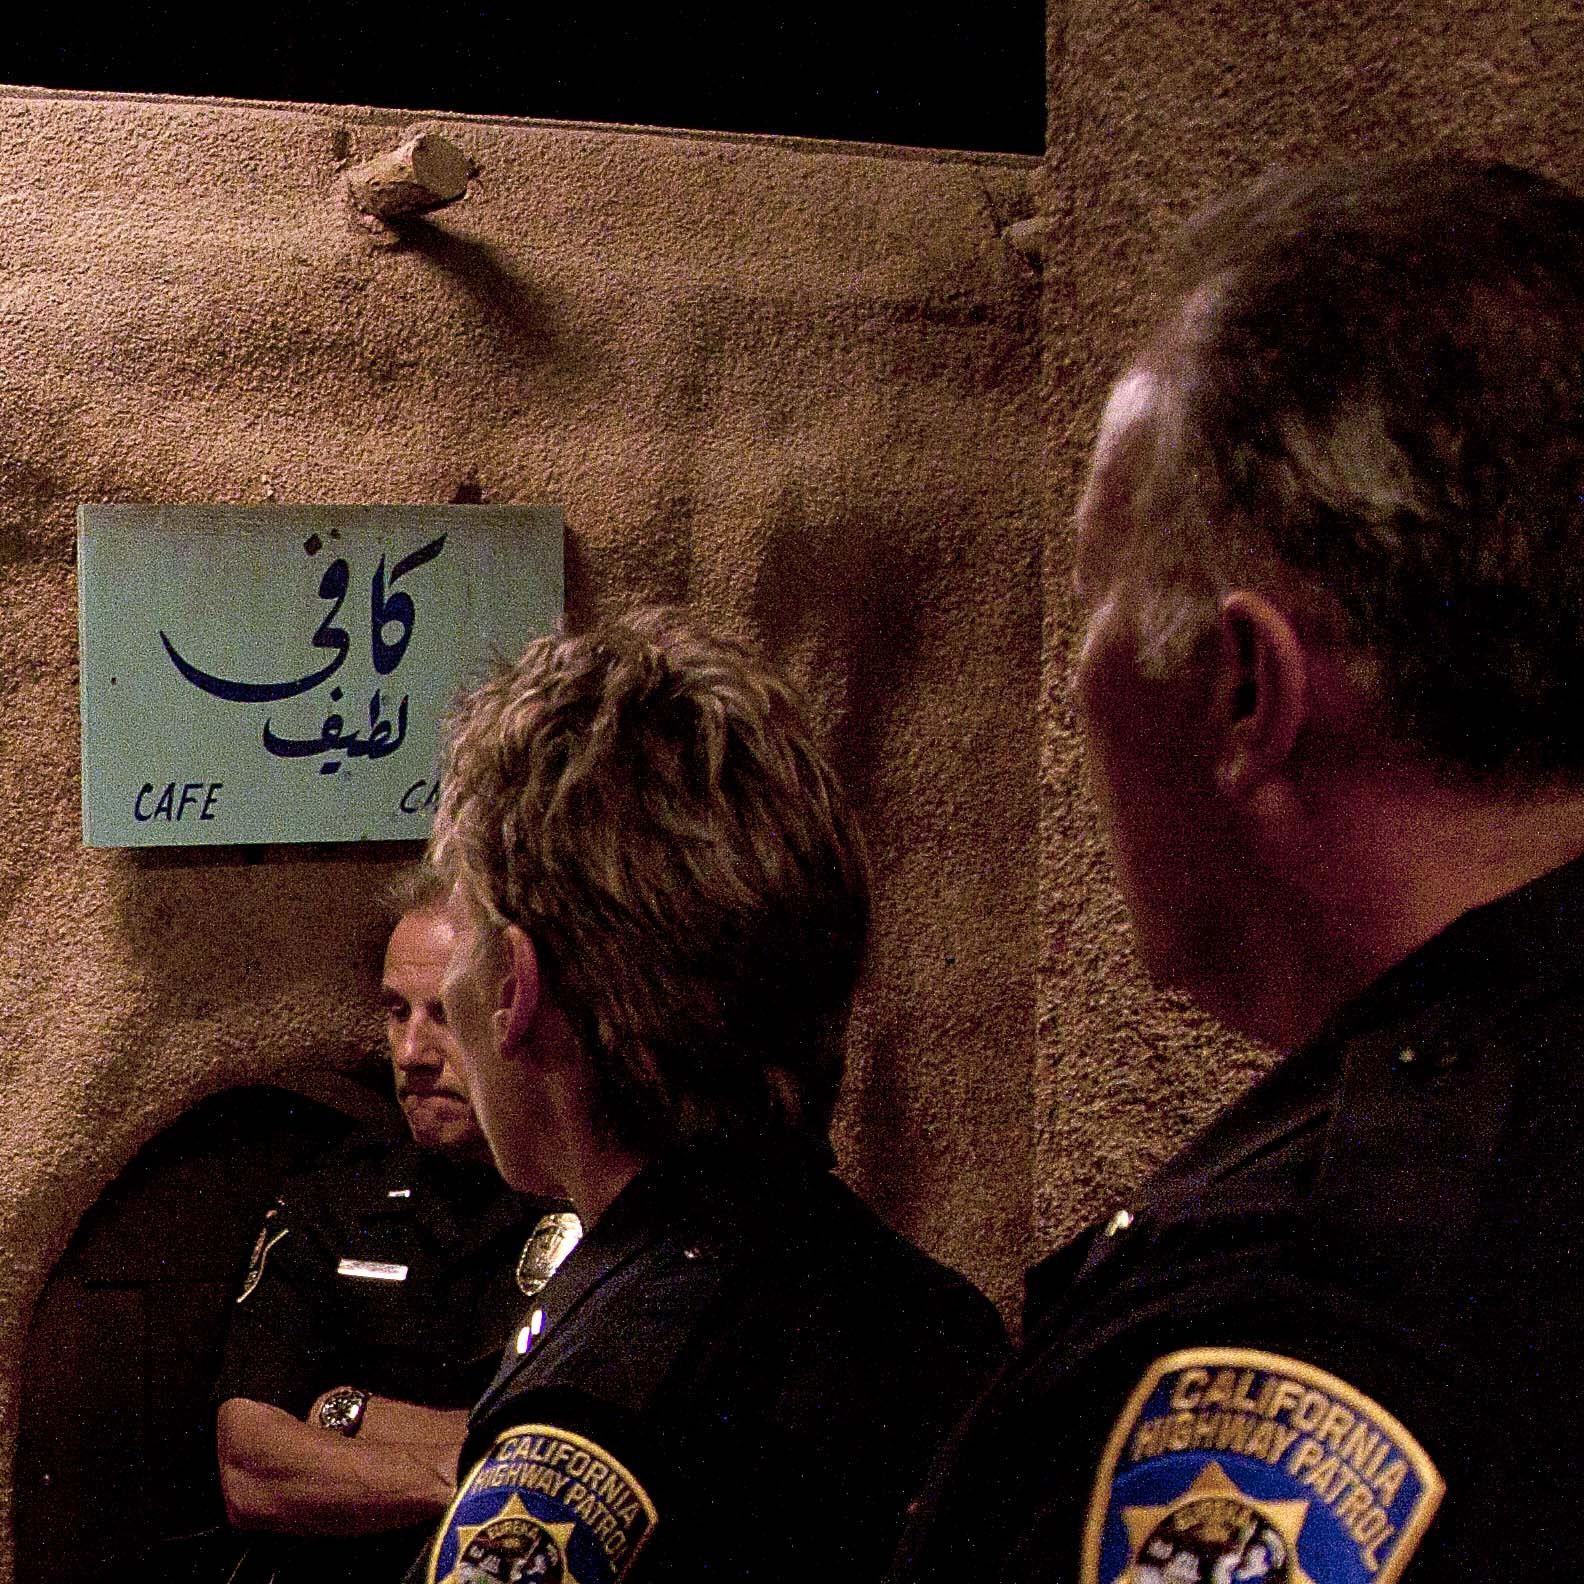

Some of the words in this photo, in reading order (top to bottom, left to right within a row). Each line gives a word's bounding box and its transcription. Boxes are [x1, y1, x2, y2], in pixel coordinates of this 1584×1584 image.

[133, 782, 224, 822] CAFE
[470, 1463, 572, 1498] HIGHWAY
[495, 1436, 643, 1529] CALIFORNIA
[1170, 1368, 1410, 1507] CALIFORNIA
[1131, 1411, 1300, 1465] HIGHWAY
[1286, 1436, 1397, 1573] PATROL
